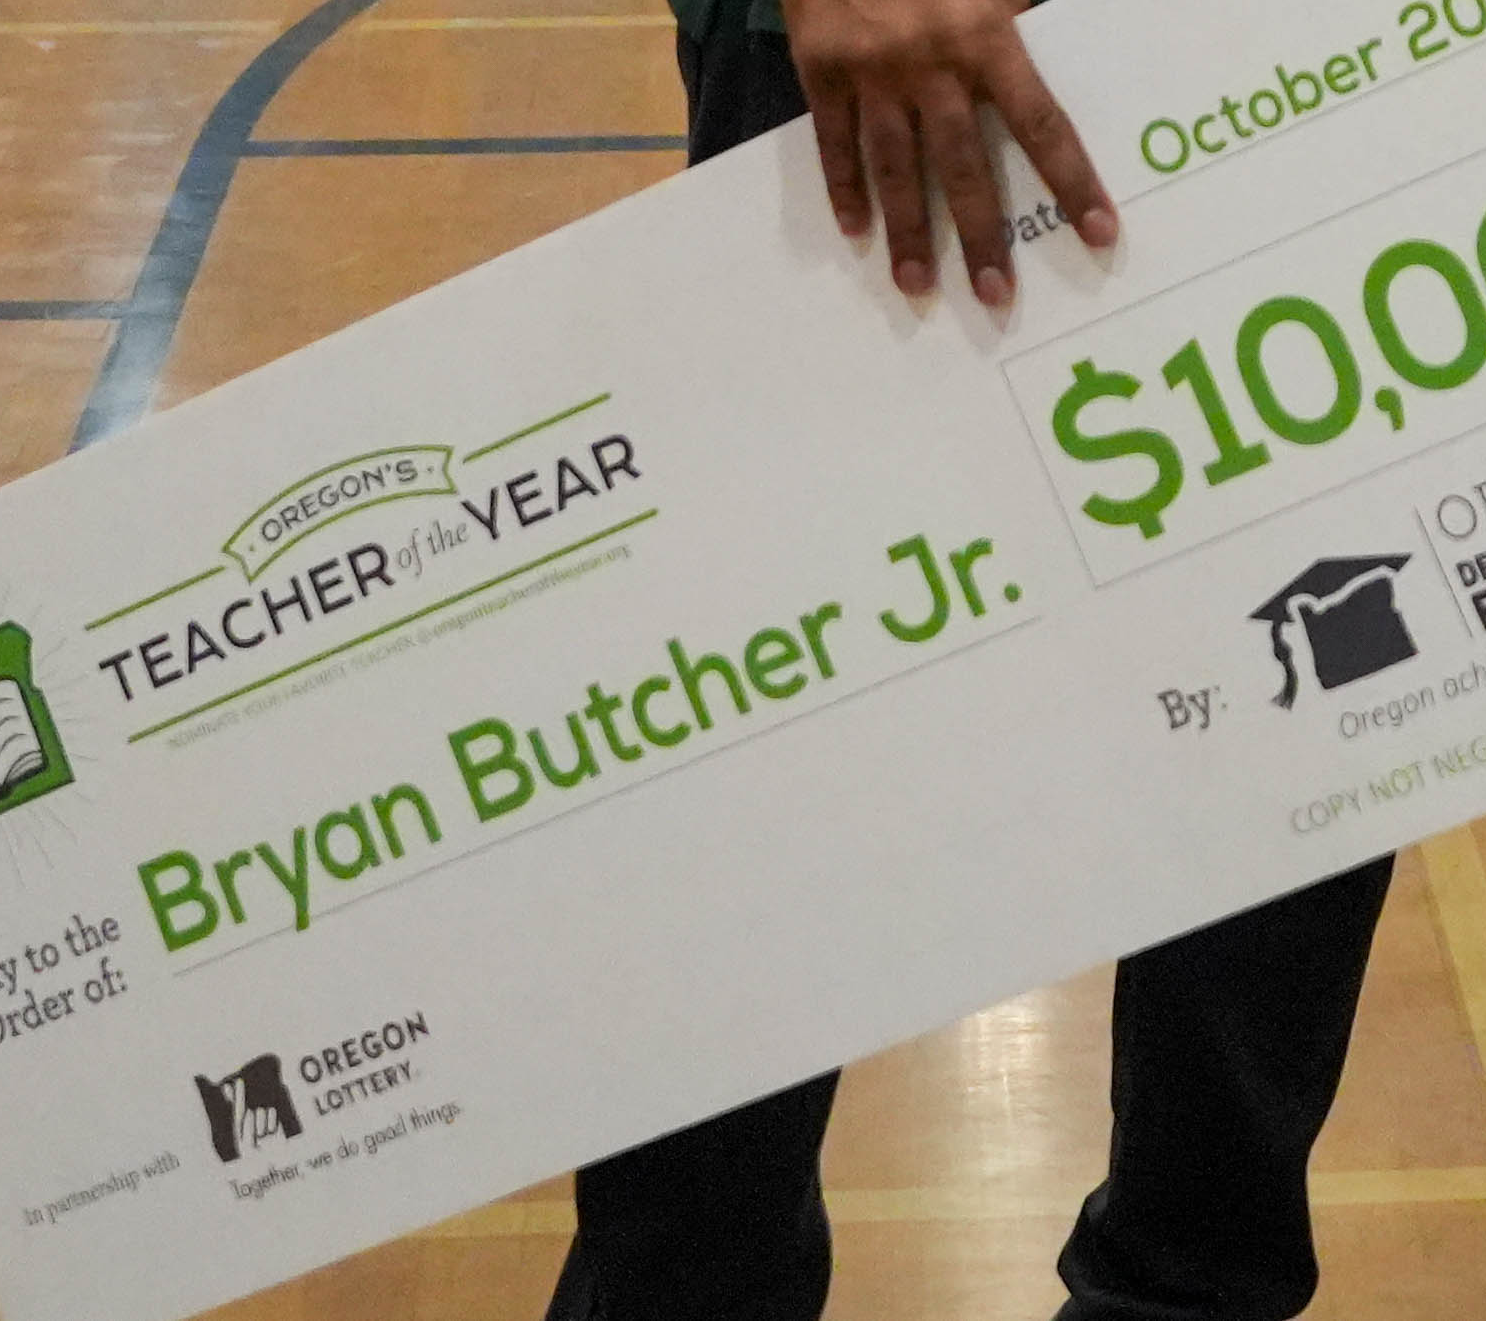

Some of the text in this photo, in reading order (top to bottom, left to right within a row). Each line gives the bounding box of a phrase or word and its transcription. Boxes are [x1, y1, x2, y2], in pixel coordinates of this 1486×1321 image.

[1139, 34, 1382, 172] October
[1006, 201, 1070, 246] at
[260, 460, 418, 543] OREGON'S
[99, 434, 642, 701] TEACHER of the YEAR
[1157, 684, 1228, 731] By:
[1339, 688, 1435, 740] Oregon
[138, 535, 1024, 951] Bryan Butcher Jr.
[1292, 789, 1361, 834] COPY
[1372, 764, 1427, 801] NOT
[25, 944, 59, 973] to
[65, 914, 121, 956] the
[84, 957, 127, 1003] of:
[300, 1011, 429, 1083] OREGON
[314, 1061, 411, 1116] LOTTERY
[146, 1151, 179, 1180] with
[308, 1152, 332, 1169] we
[338, 1133, 360, 1159] do
[365, 1115, 406, 1154] good
